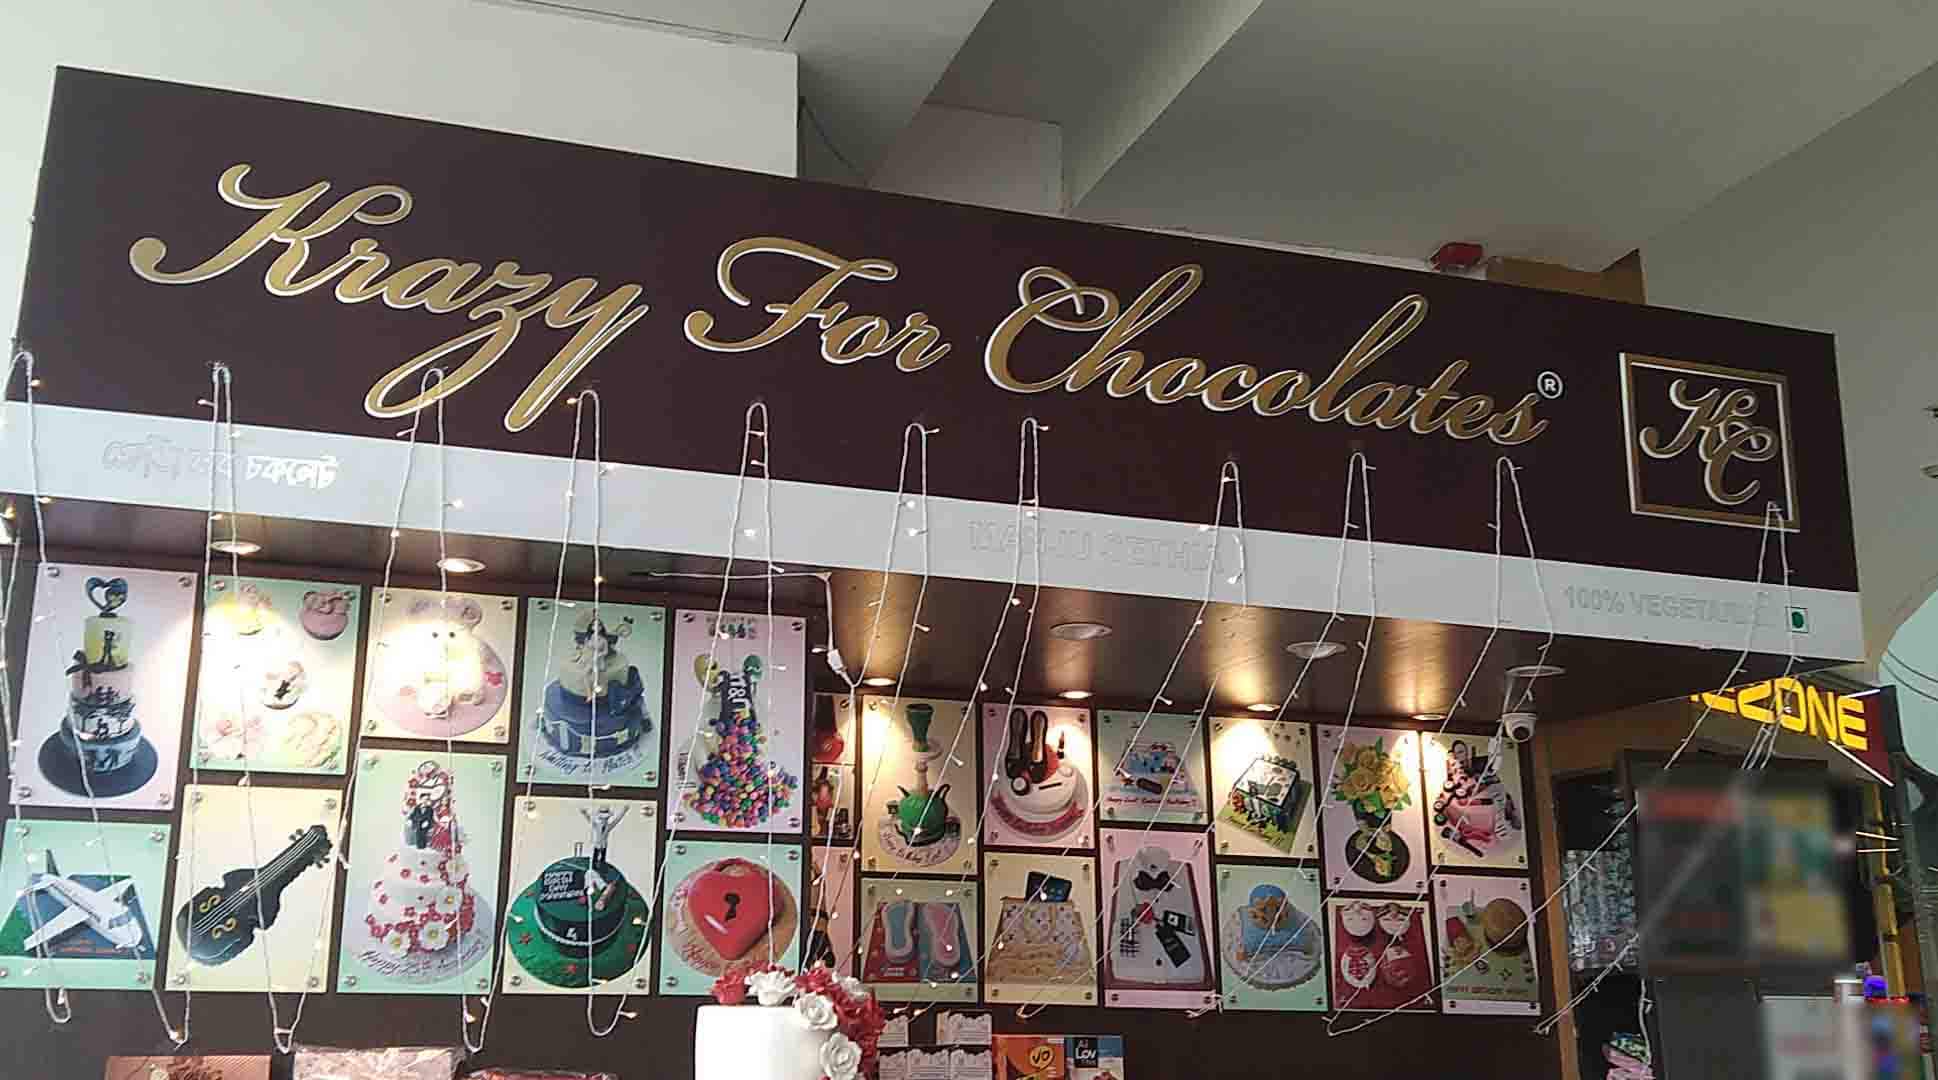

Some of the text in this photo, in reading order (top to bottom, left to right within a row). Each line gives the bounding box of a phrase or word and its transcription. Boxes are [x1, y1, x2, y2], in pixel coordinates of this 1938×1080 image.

[128, 163, 650, 432] Krazy
[684, 236, 951, 372] For
[985, 263, 1550, 445] Chocolates
